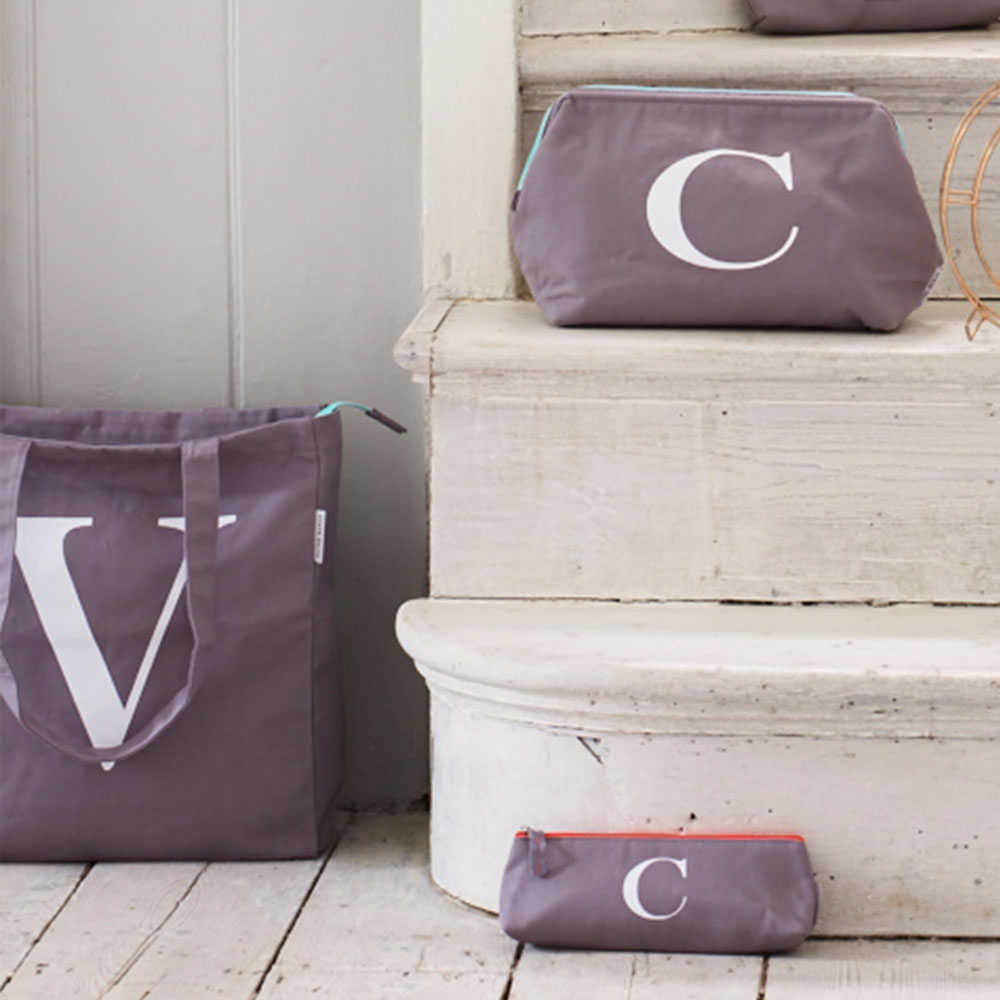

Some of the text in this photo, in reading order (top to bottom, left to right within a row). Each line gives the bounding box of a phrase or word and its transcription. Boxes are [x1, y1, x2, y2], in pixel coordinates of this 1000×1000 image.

[646, 148, 799, 271] C
[15, 515, 237, 771] V
[622, 856, 688, 921] C
